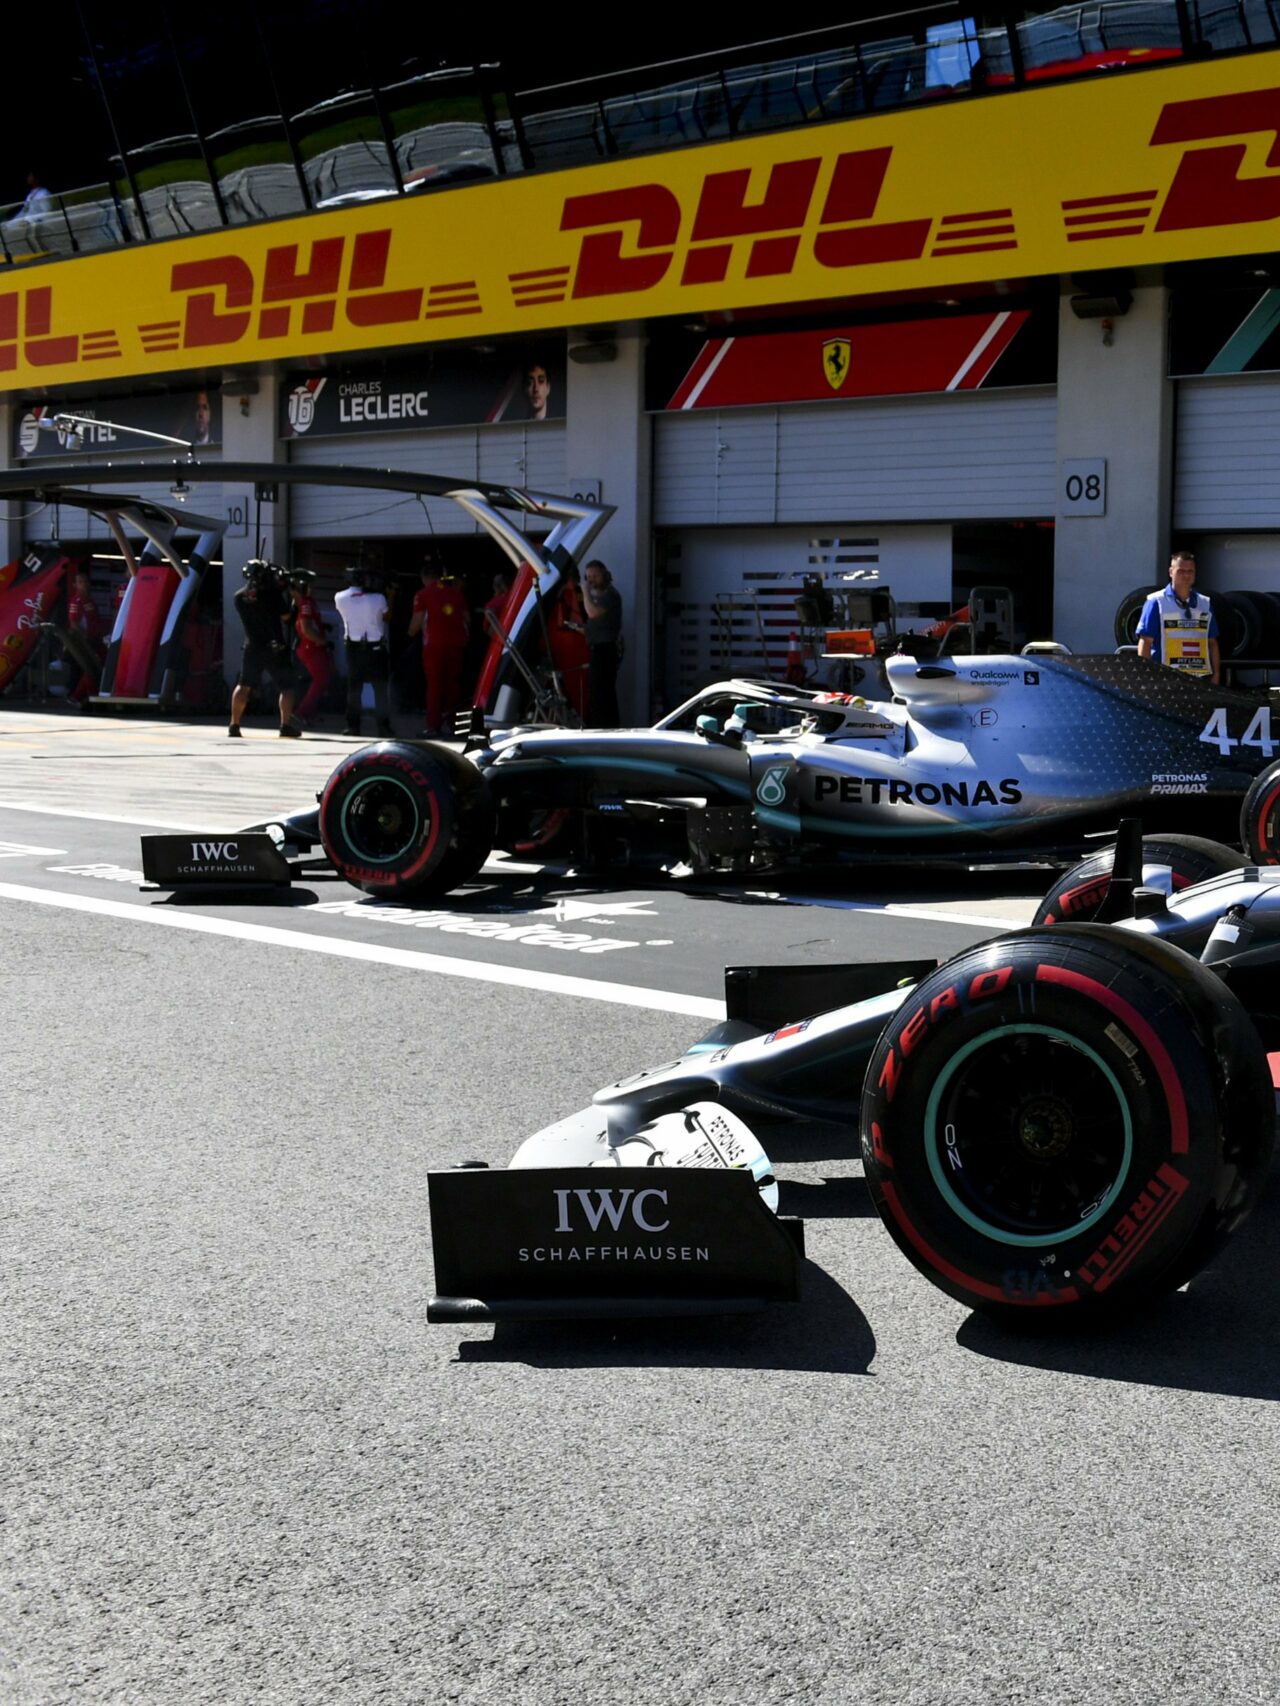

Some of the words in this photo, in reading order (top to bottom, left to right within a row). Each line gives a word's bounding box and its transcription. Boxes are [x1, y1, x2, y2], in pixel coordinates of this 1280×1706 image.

[559, 146, 933, 300] DHL
[170, 228, 424, 348] DHL
[338, 381, 382, 397] CHARLES
[288, 392, 314, 426] 16
[339, 391, 428, 422] LECLERC
[57, 421, 117, 446] VTEL
[1065, 474, 1101, 500] 08
[227, 507, 242, 526] 10
[970, 670, 1020, 680] Qualcomm
[980, 710, 992, 726] E
[1199, 706, 1280, 758] 44
[815, 775, 1023, 807] PETRONAS
[1149, 783, 1209, 795] PRIMAX
[1151, 773, 1208, 783] PETRONAS
[190, 842, 239, 862] IWC
[177, 865, 256, 873] SCHAFFHAUSEN
[877, 965, 1015, 1103] ZERO
[709, 1114, 745, 1162] PETRONAS
[553, 1188, 671, 1233] IWC
[1077, 1163, 1192, 1294] PIRELLI
[518, 1246, 710, 1263] SCHAFFHAUSEN
